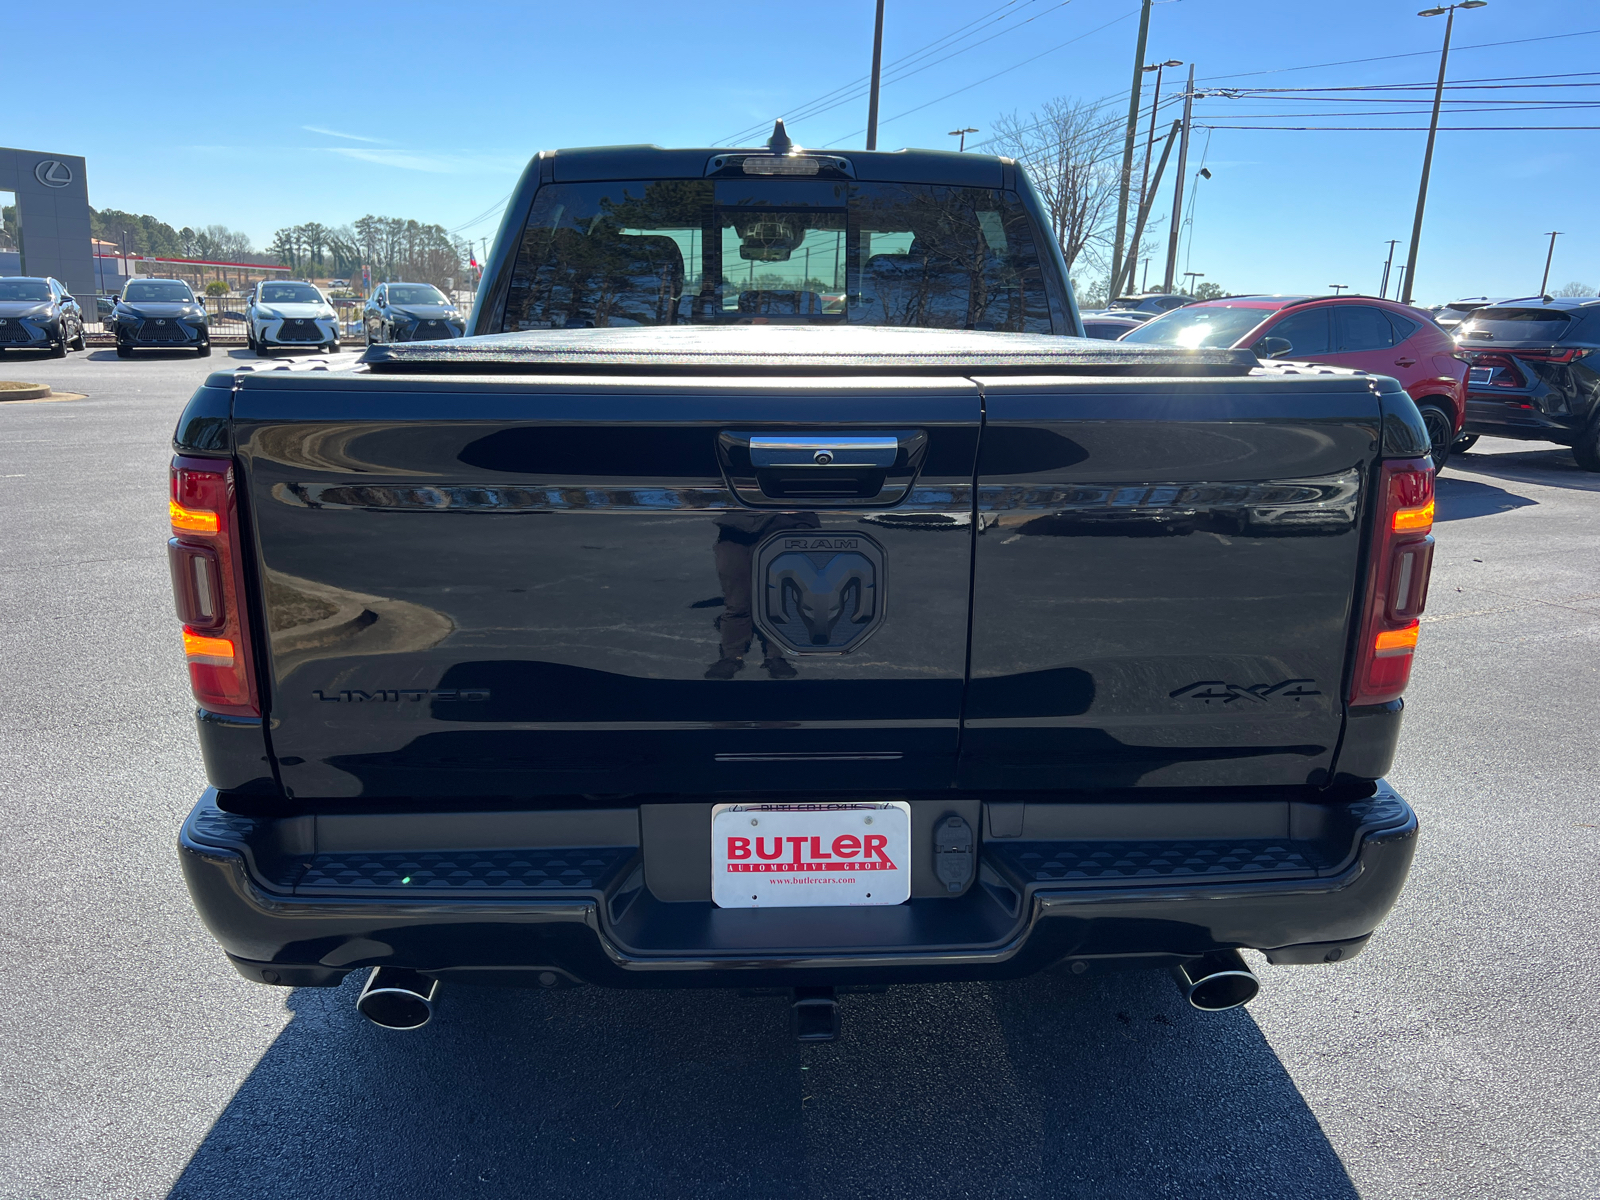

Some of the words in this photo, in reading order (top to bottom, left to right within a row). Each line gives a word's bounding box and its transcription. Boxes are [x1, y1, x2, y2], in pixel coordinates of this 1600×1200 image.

[784, 539, 858, 549] RAM
[312, 688, 491, 702] LIMITED
[728, 863, 827, 872] AUTOMOTIVE
[844, 862, 893, 870] GROUP
[769, 876, 856, 885] www.butlercars.com
